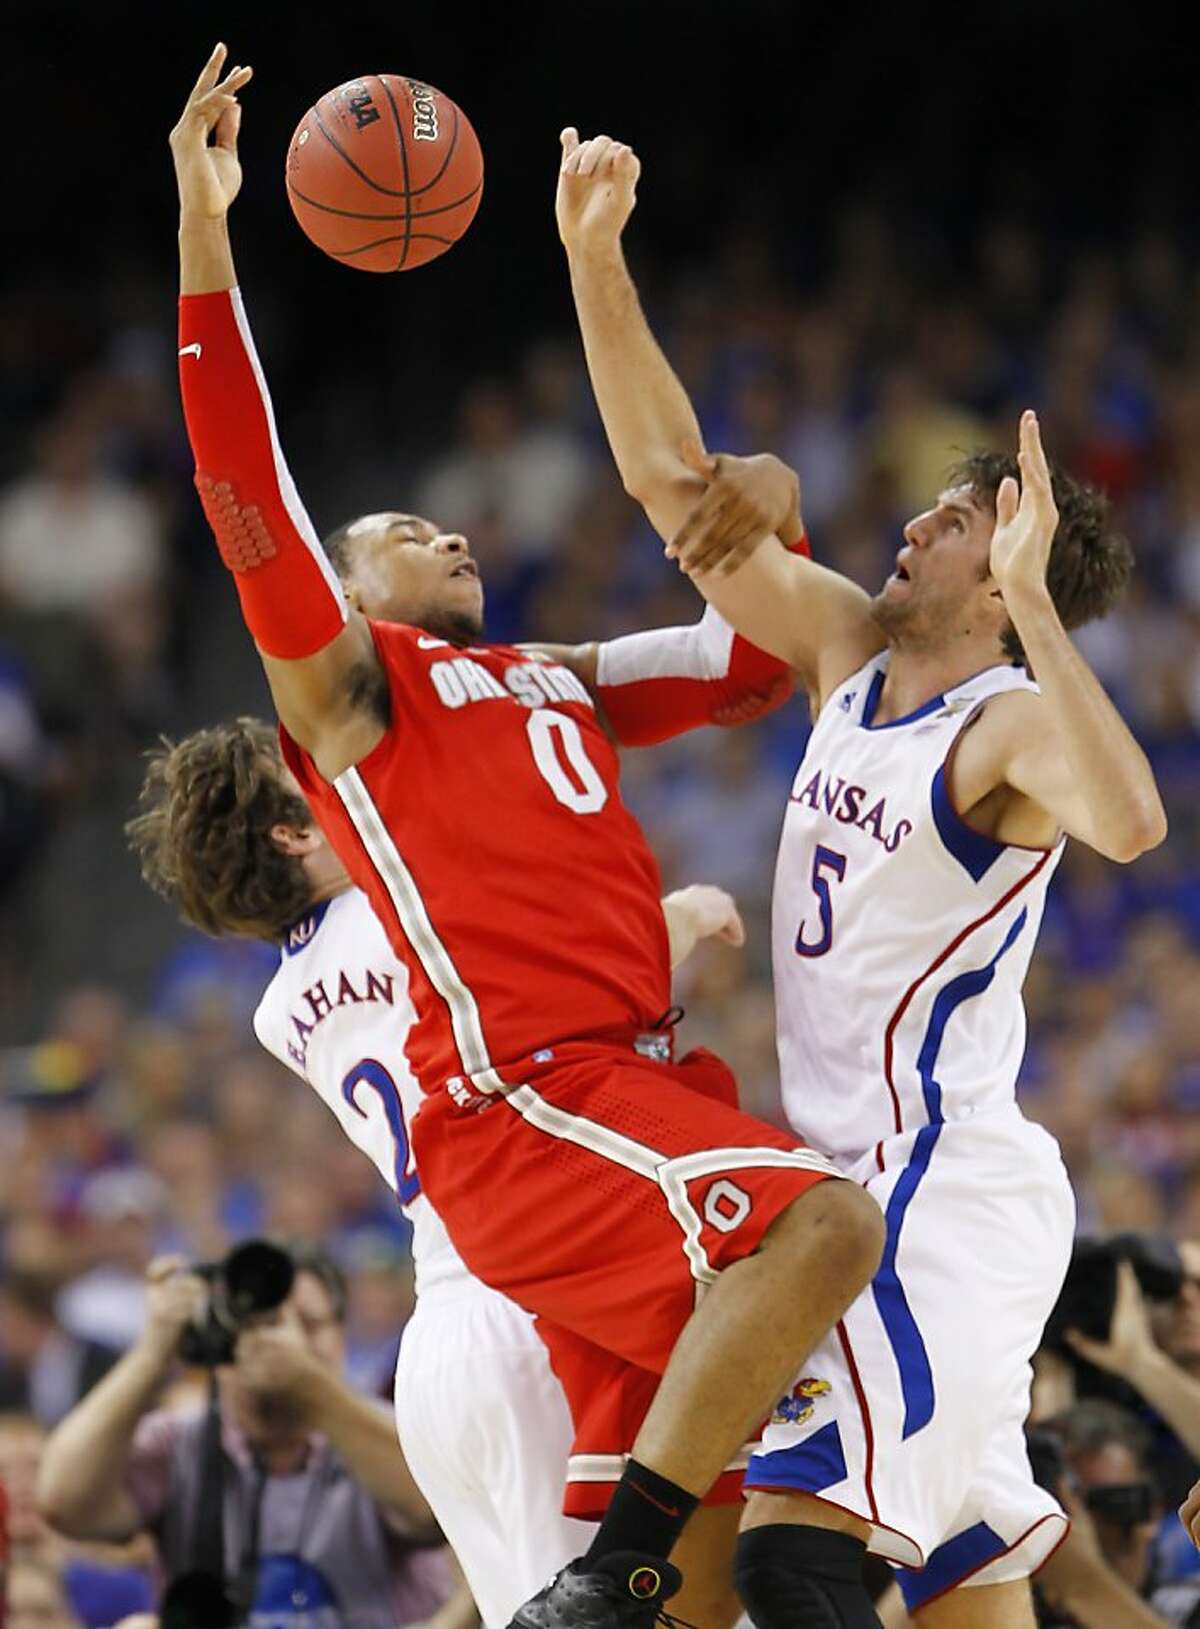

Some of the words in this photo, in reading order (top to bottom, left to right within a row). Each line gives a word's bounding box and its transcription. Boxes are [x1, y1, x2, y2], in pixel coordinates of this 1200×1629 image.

[527, 708, 608, 814] 0
[789, 769, 912, 852] ANSAS
[795, 844, 847, 959] 5
[286, 969, 394, 1071] EAHAN
[342, 1058, 422, 1207] 2
